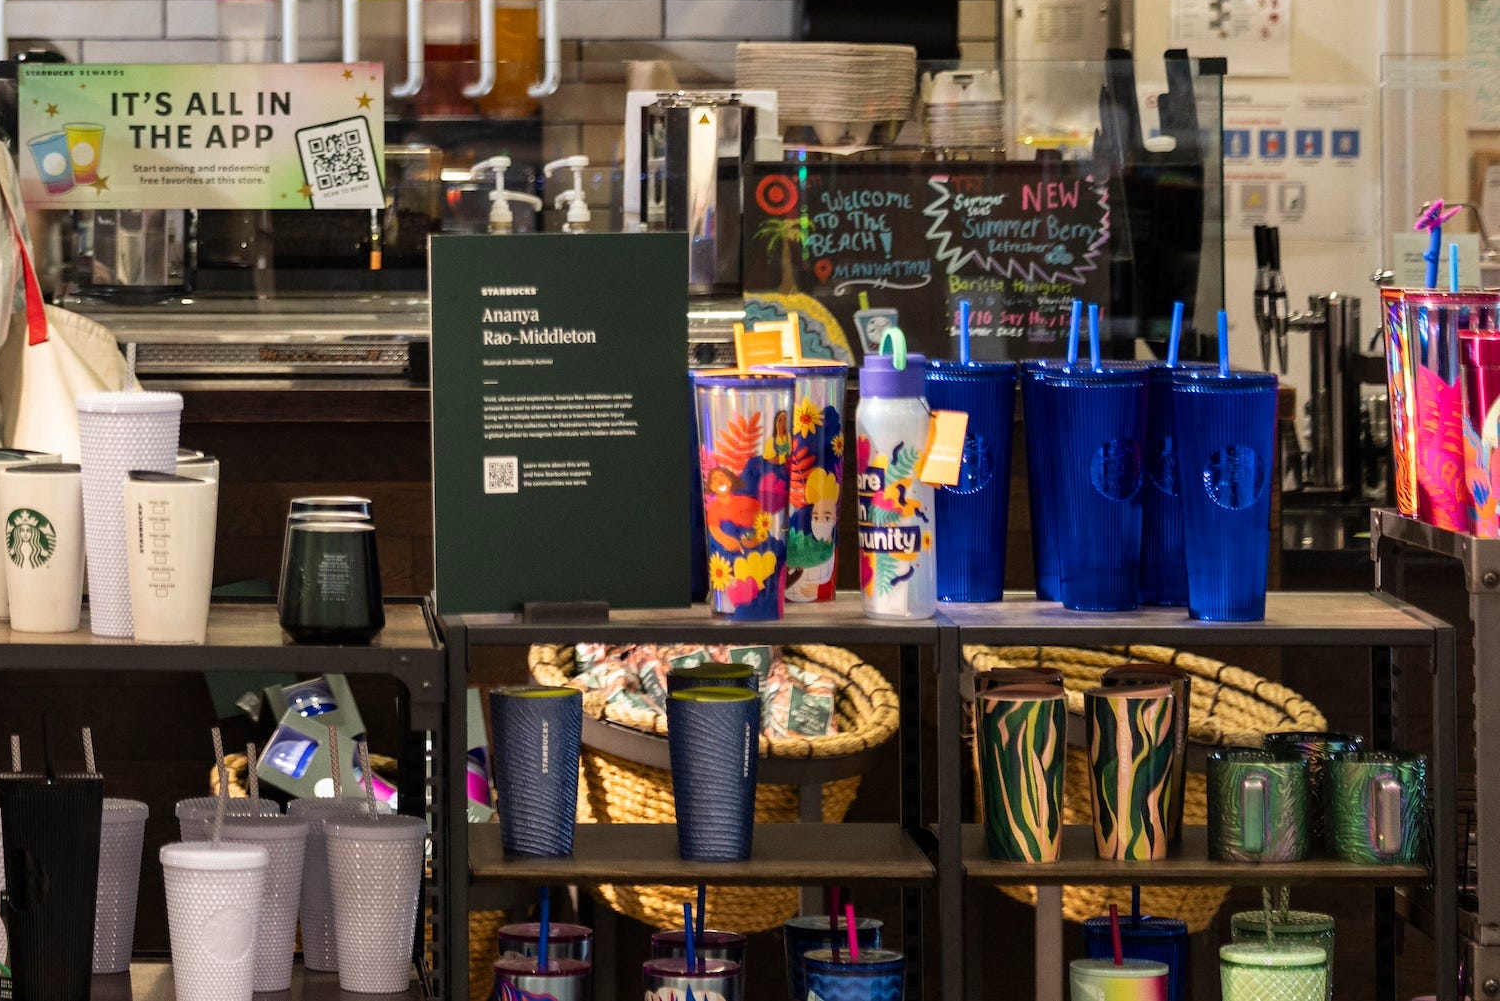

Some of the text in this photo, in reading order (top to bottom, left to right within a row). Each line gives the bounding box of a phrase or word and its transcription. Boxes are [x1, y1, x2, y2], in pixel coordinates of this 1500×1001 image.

[111, 91, 291, 117] IT'S ALL IN
[129, 125, 275, 150] THE APP
[133, 163, 270, 176] Start earning and redeeming
[139, 175, 266, 185] free favorites at this store.
[1021, 180, 1080, 212] NEW
[962, 214, 1098, 245] Summer Berry
[833, 259, 932, 279] MANHATTAN
[481, 287, 538, 297] STARBUCKS
[948, 274, 1073, 295] Barista thoughts
[482, 308, 540, 325] Ananya
[483, 327, 597, 347] Rao-Middleton
[552, 461, 566, 470] about
[567, 461, 576, 470] this
[743, 721, 751, 778] STARBUCKS
